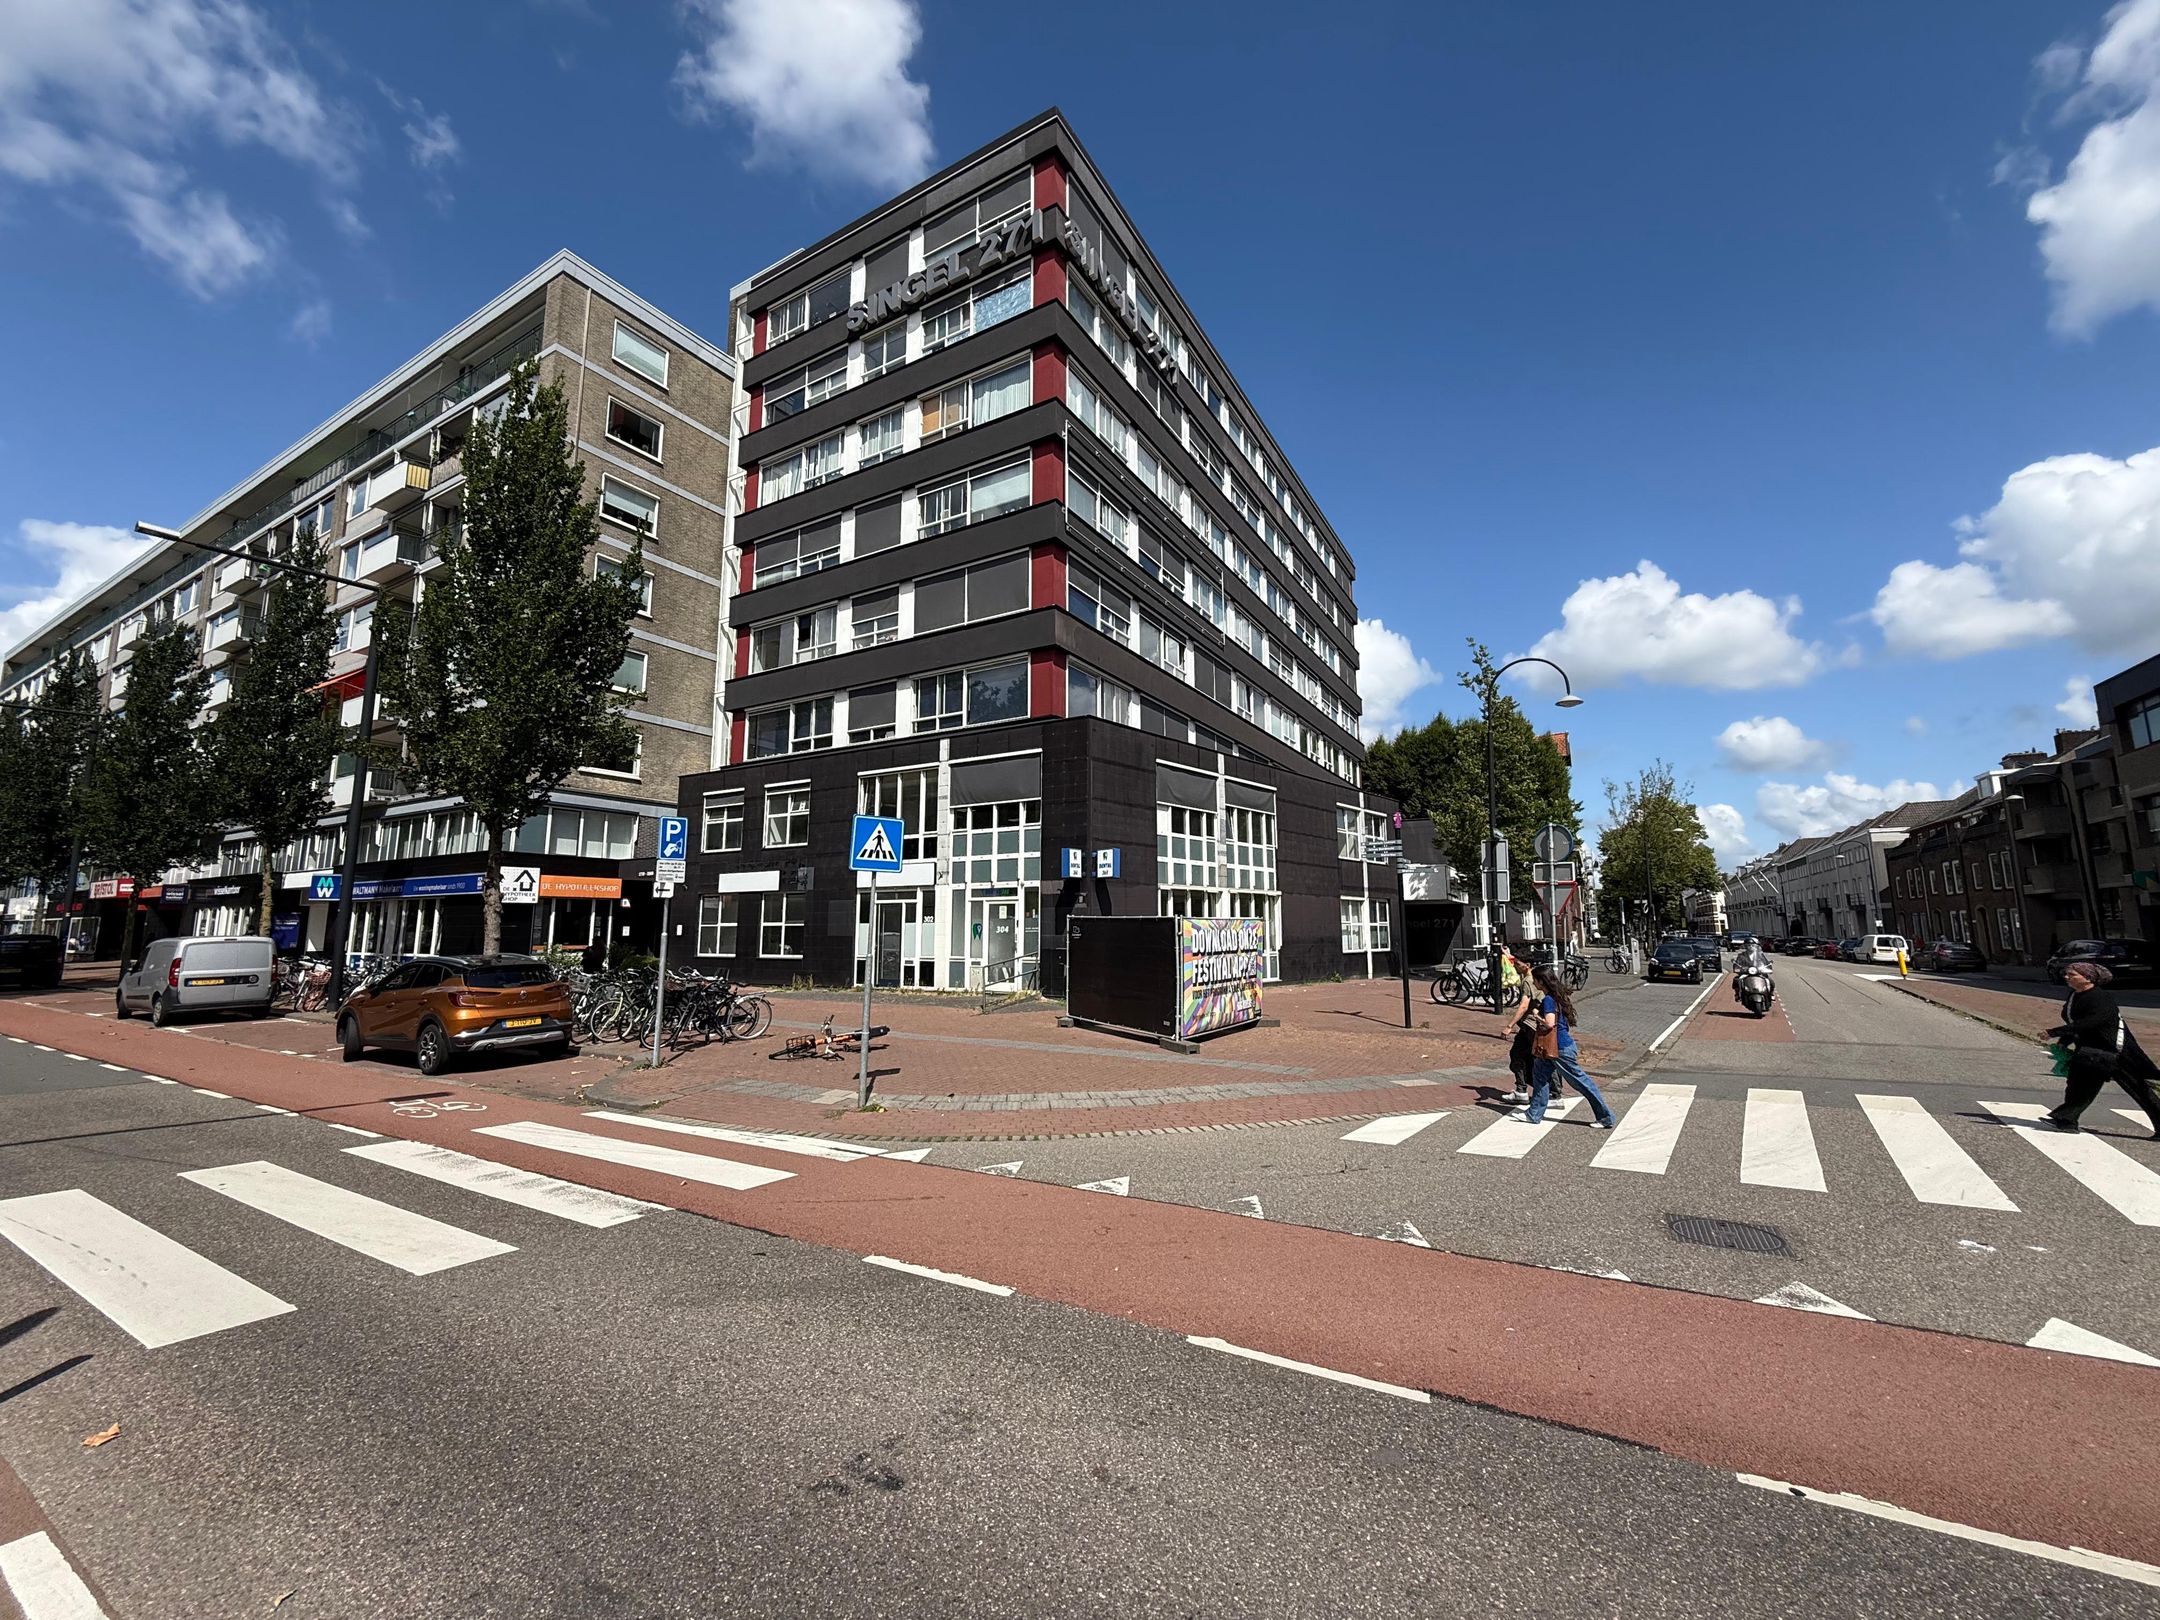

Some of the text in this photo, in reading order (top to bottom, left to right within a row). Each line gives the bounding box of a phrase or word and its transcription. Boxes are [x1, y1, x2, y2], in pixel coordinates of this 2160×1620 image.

[846, 208, 1044, 333] SINGEL 271
[1064, 220, 1179, 386] SINGEL 271
[665, 820, 682, 842] P
[94, 883, 113, 896] BRISTOL
[541, 882, 620, 892] DE HYPOTHEEKSHOP
[923, 915, 934, 923] 302
[996, 925, 1009, 934] 304
[1192, 927, 1258, 954] DOWNLOAD ONZE
[1192, 955, 1249, 984] FESTIVAL APP
